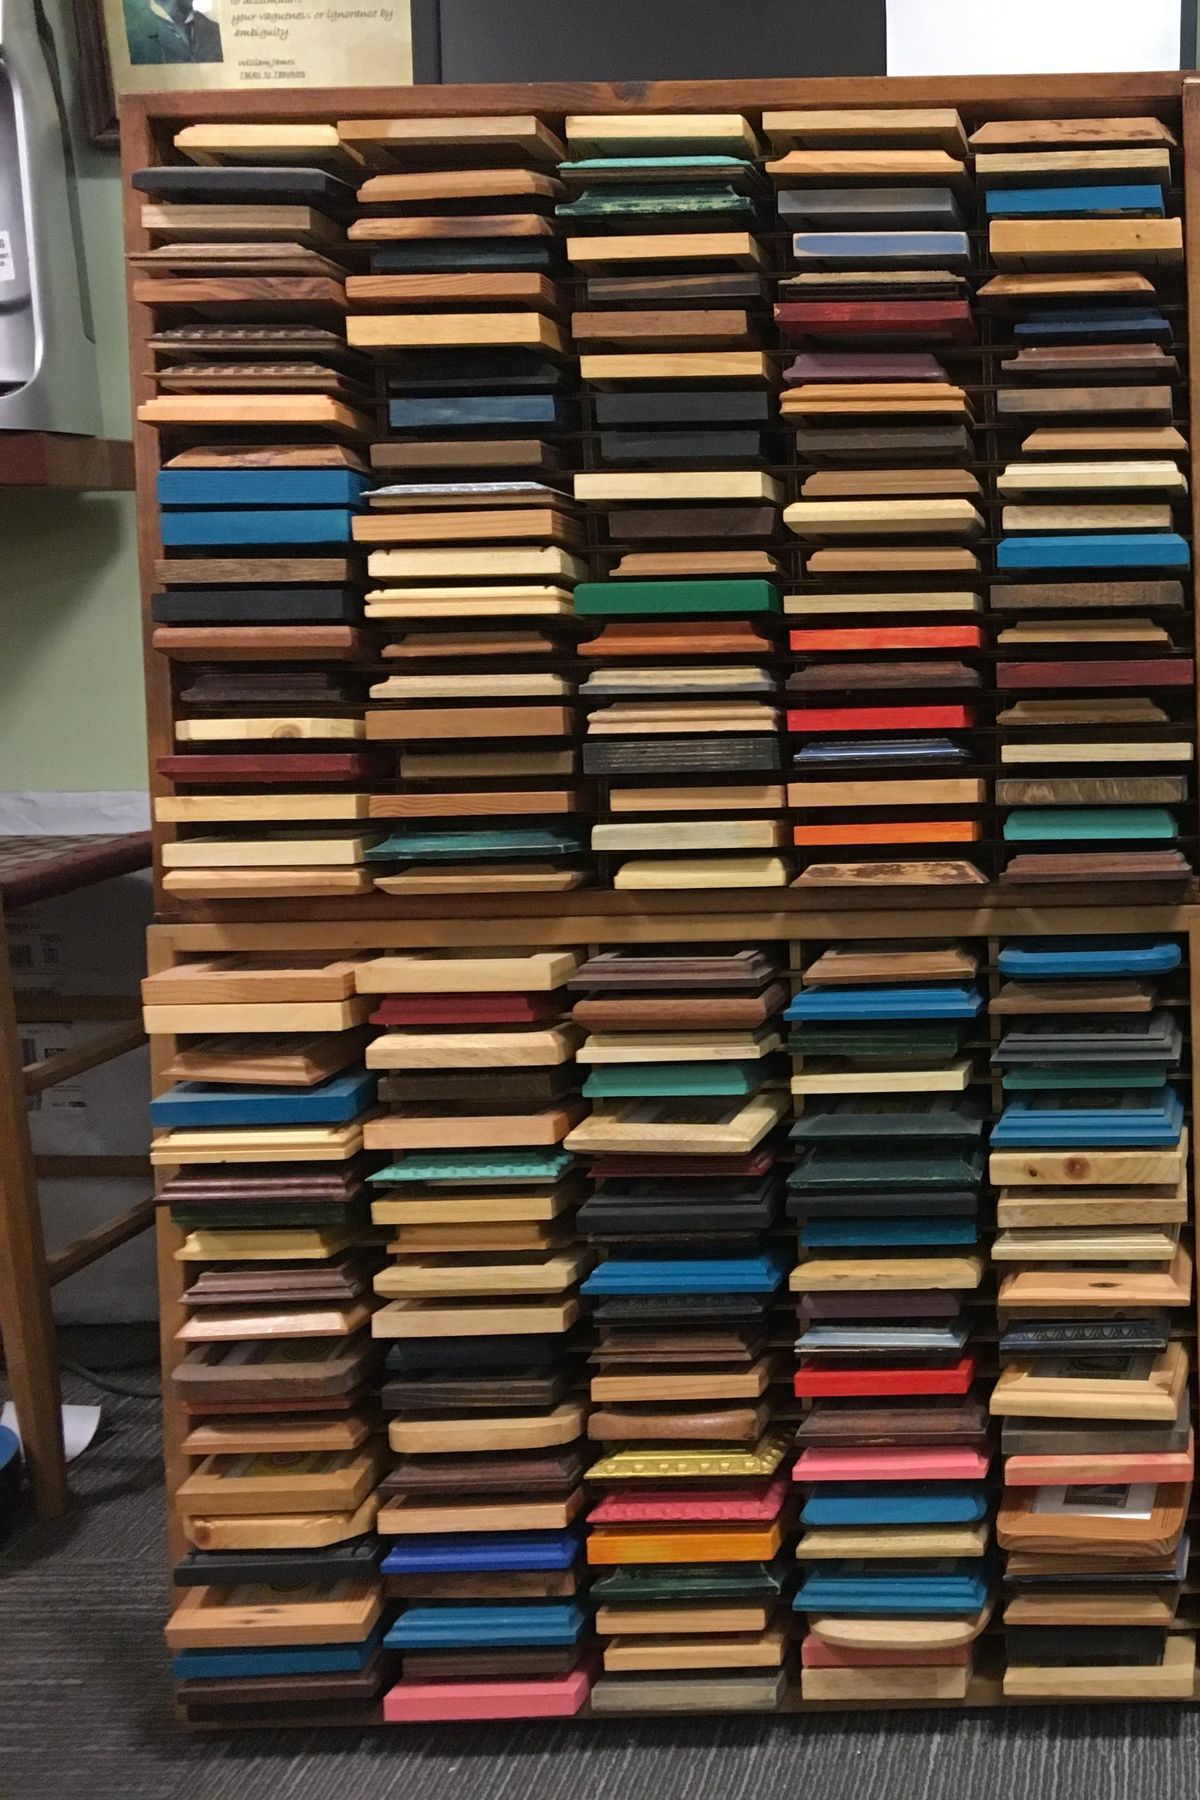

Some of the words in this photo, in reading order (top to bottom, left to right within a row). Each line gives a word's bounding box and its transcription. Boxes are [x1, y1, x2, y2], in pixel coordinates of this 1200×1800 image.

[231, 13, 255, 26] your
[259, 11, 311, 23] vagueness
[326, 8, 377, 22] ignorance
[379, 8, 393, 22] by
